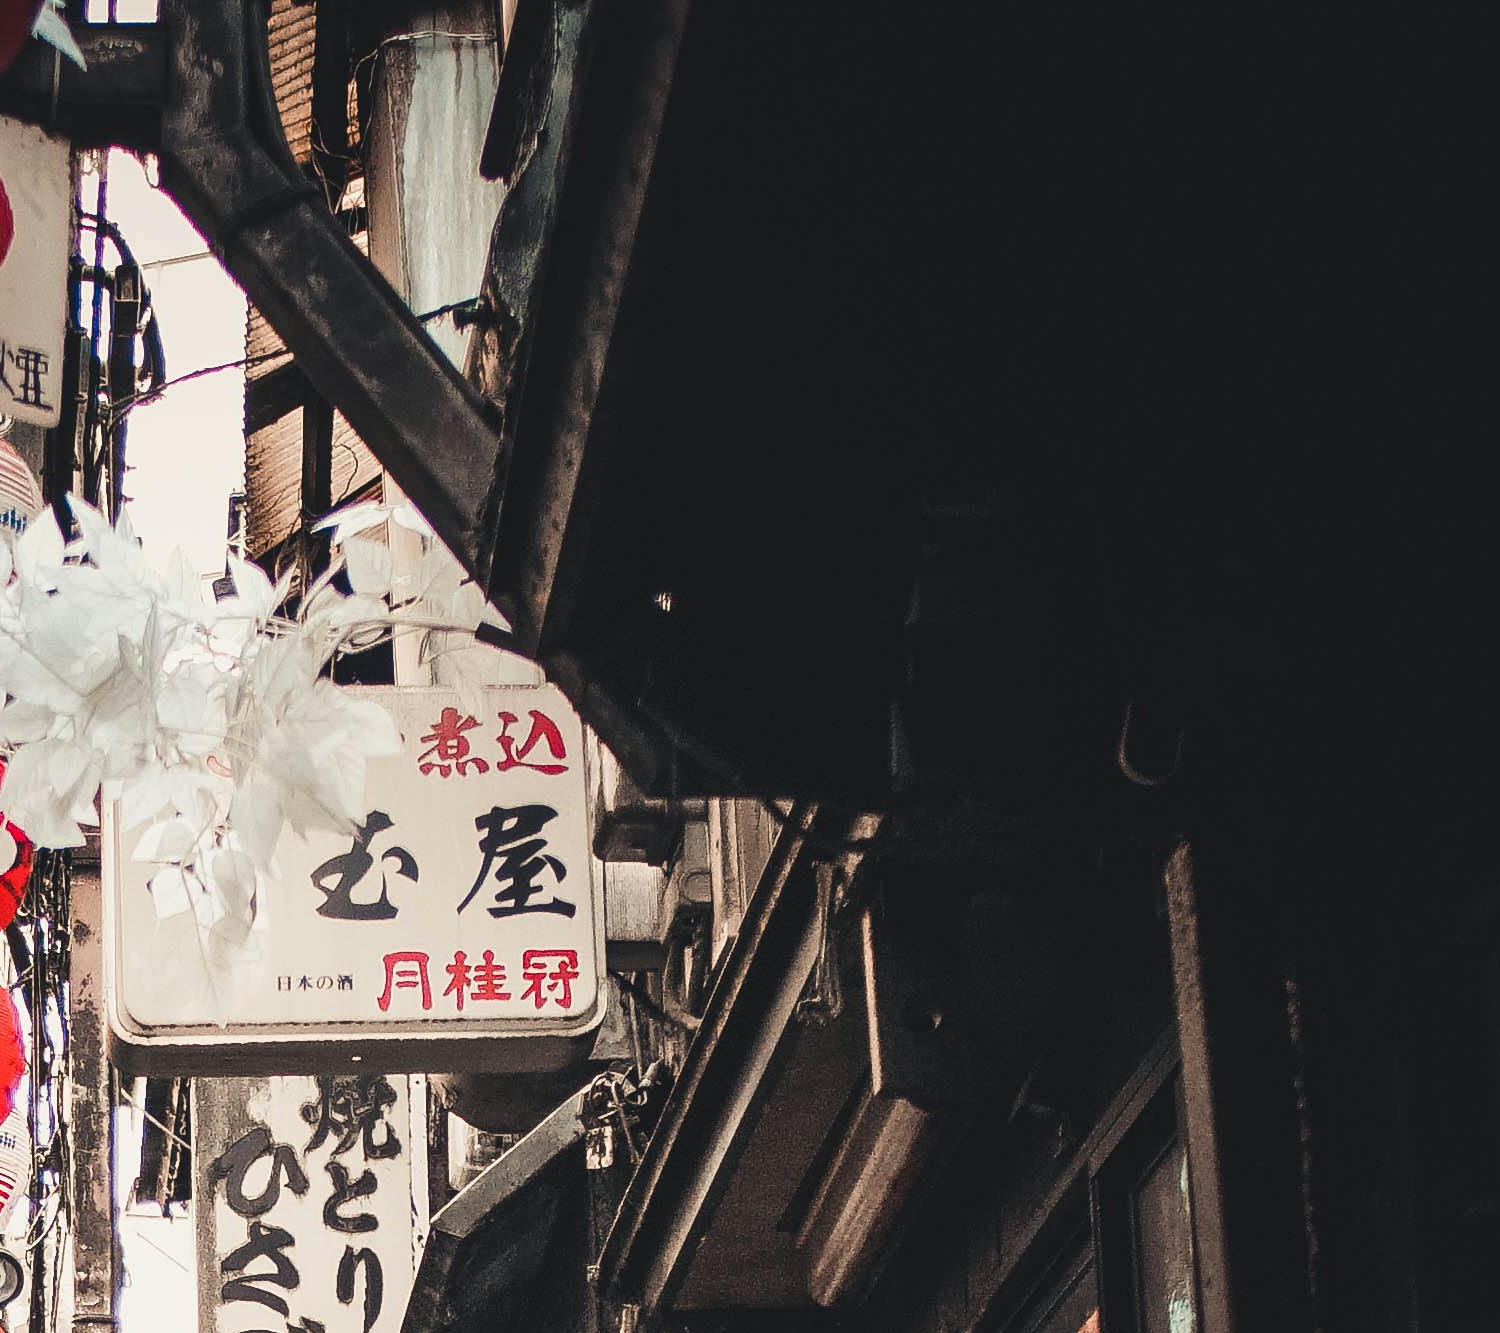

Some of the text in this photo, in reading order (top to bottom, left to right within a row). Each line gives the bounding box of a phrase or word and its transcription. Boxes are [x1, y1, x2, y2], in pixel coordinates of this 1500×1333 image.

[418, 707, 569, 778] 煮込
[277, 974, 354, 992] 日本の酒
[377, 949, 580, 1011] 月桂冠
